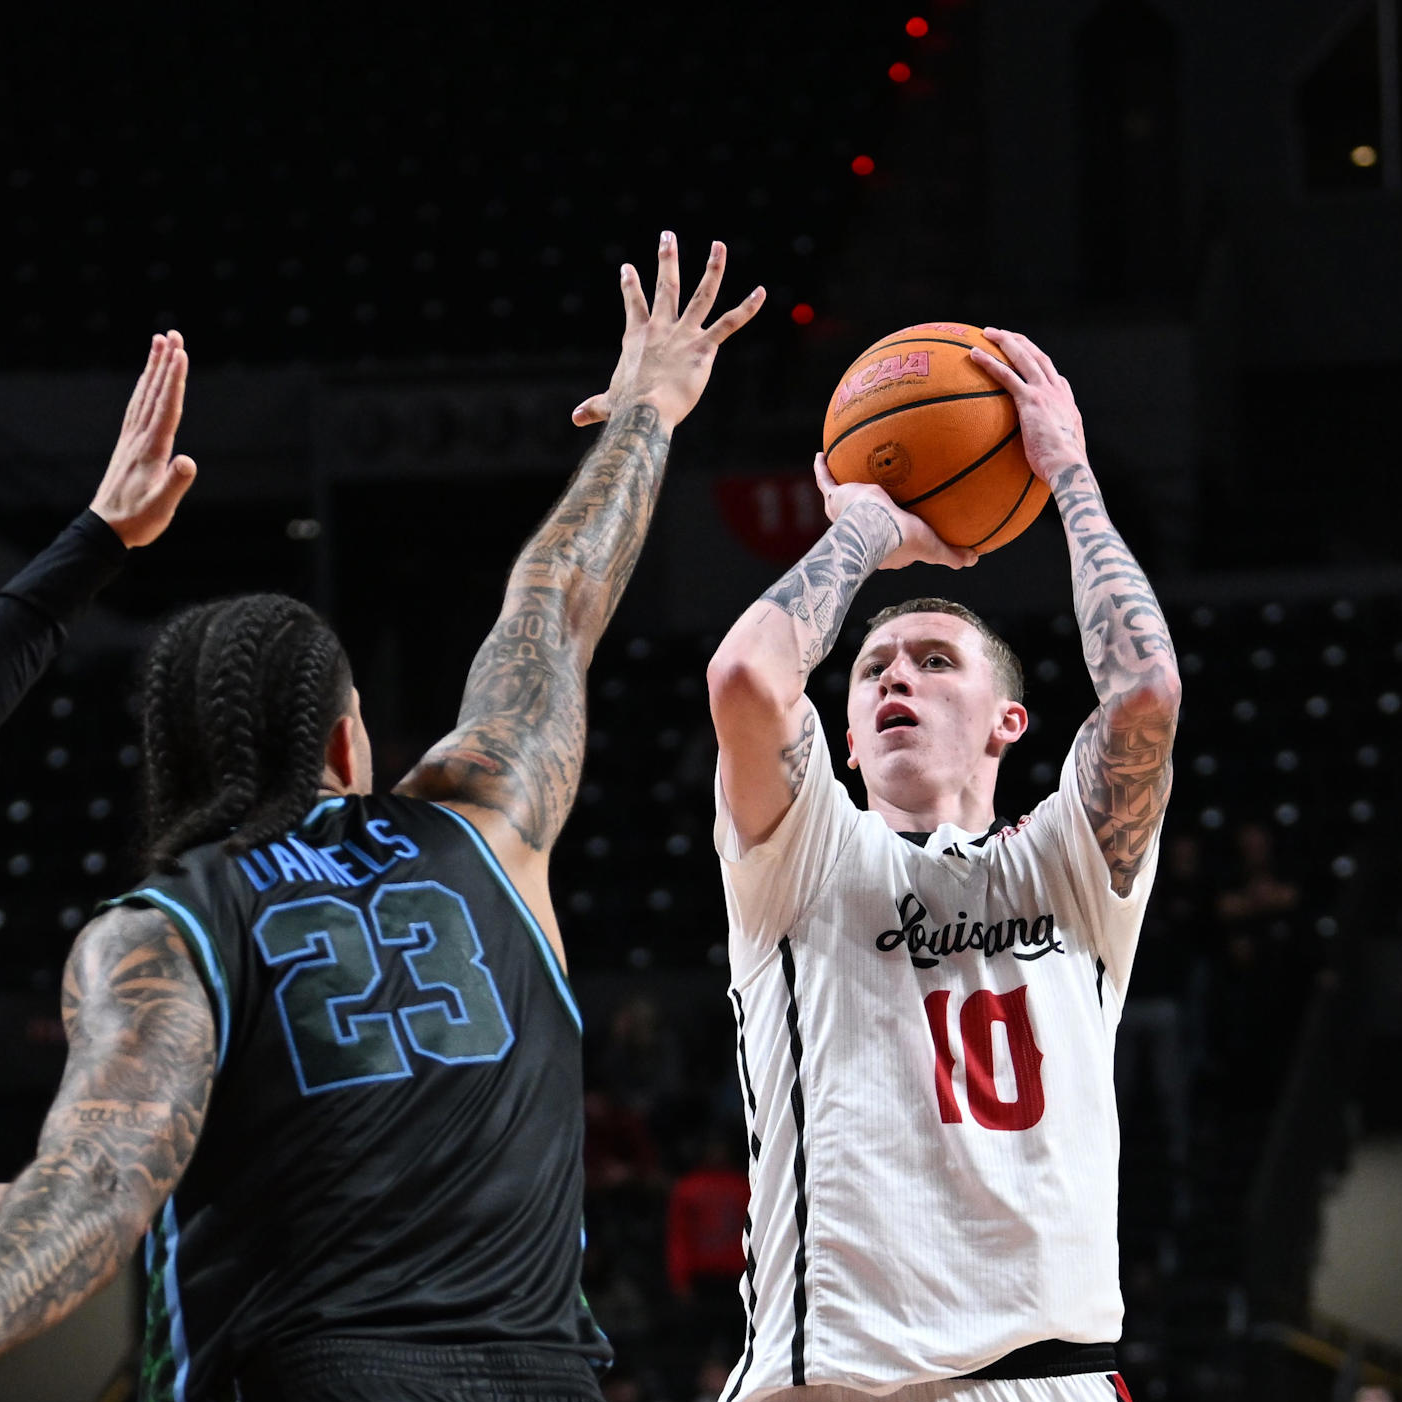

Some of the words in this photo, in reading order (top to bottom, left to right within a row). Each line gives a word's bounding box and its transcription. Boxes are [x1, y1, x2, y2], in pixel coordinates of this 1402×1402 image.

[833, 350, 931, 414] NCAA
[755, 480, 817, 534] 11
[236, 817, 421, 893] DANELS
[875, 891, 1066, 970] Louisana
[252, 879, 517, 1098] 23
[923, 984, 1046, 1132] 10
